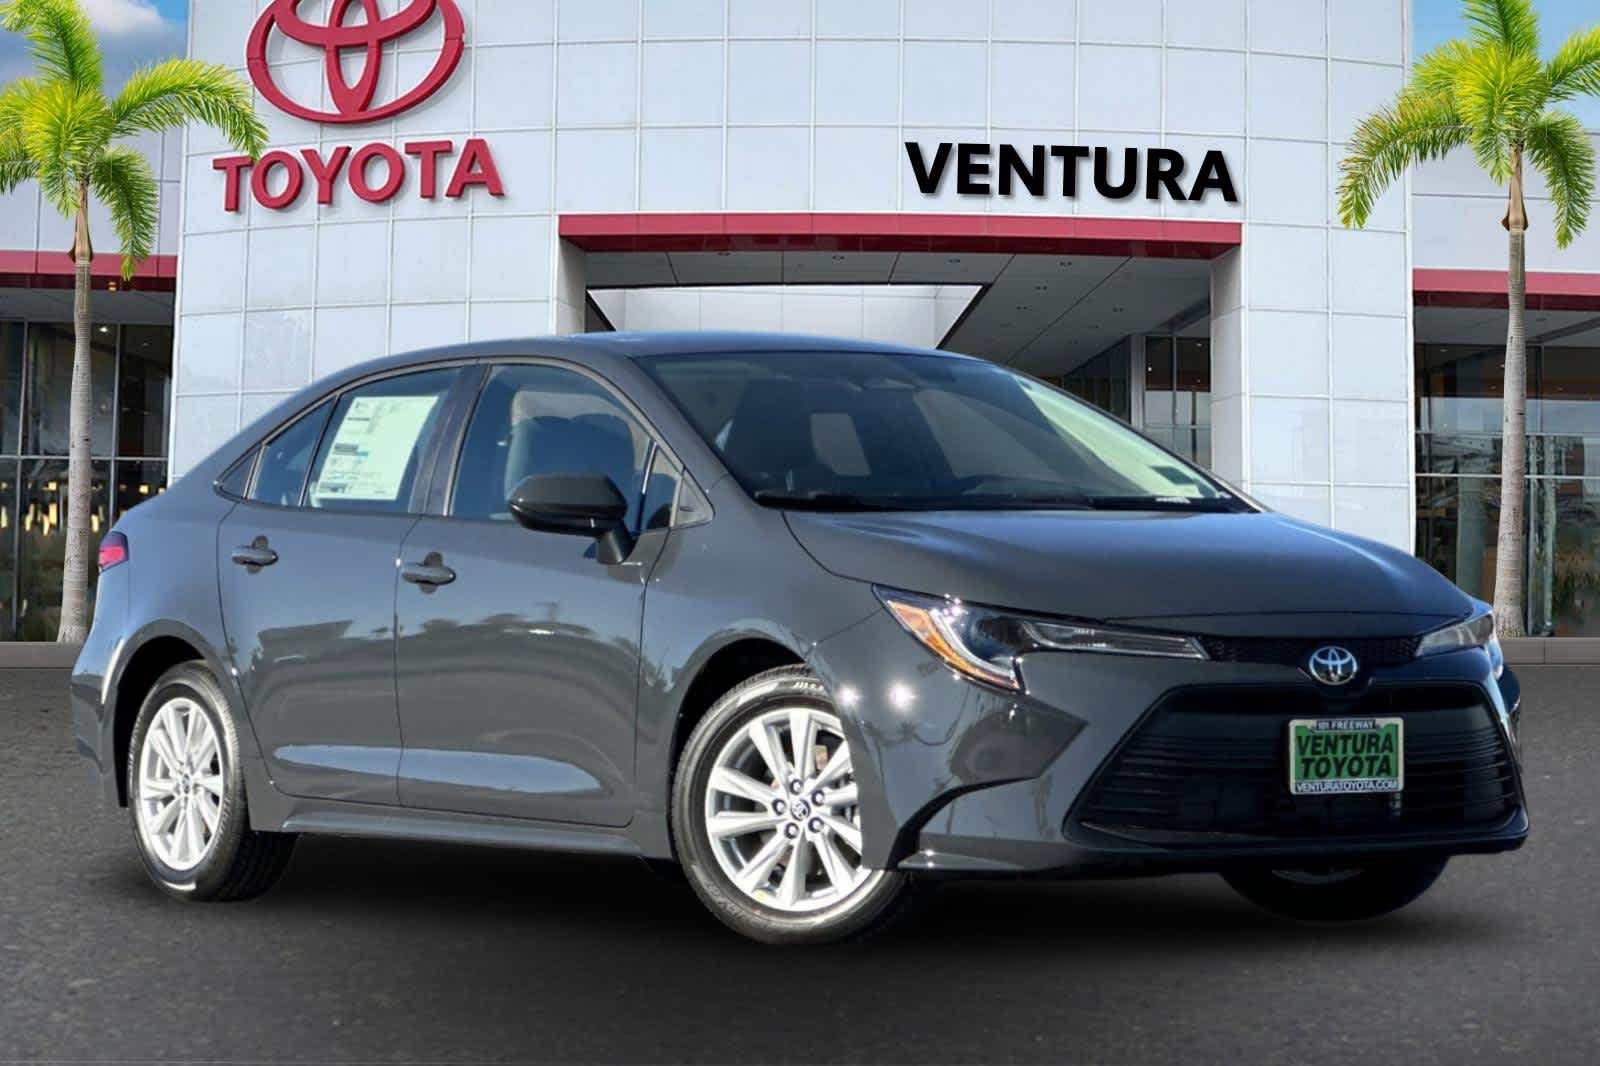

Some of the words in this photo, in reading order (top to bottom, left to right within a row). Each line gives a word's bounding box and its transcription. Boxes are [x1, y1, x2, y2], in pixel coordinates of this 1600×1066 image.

[212, 138, 505, 212] TOYOTA
[904, 141, 1239, 204] VENTURA
[1297, 732, 1394, 756] VENTURA
[1301, 755, 1392, 779] TOYOTA
